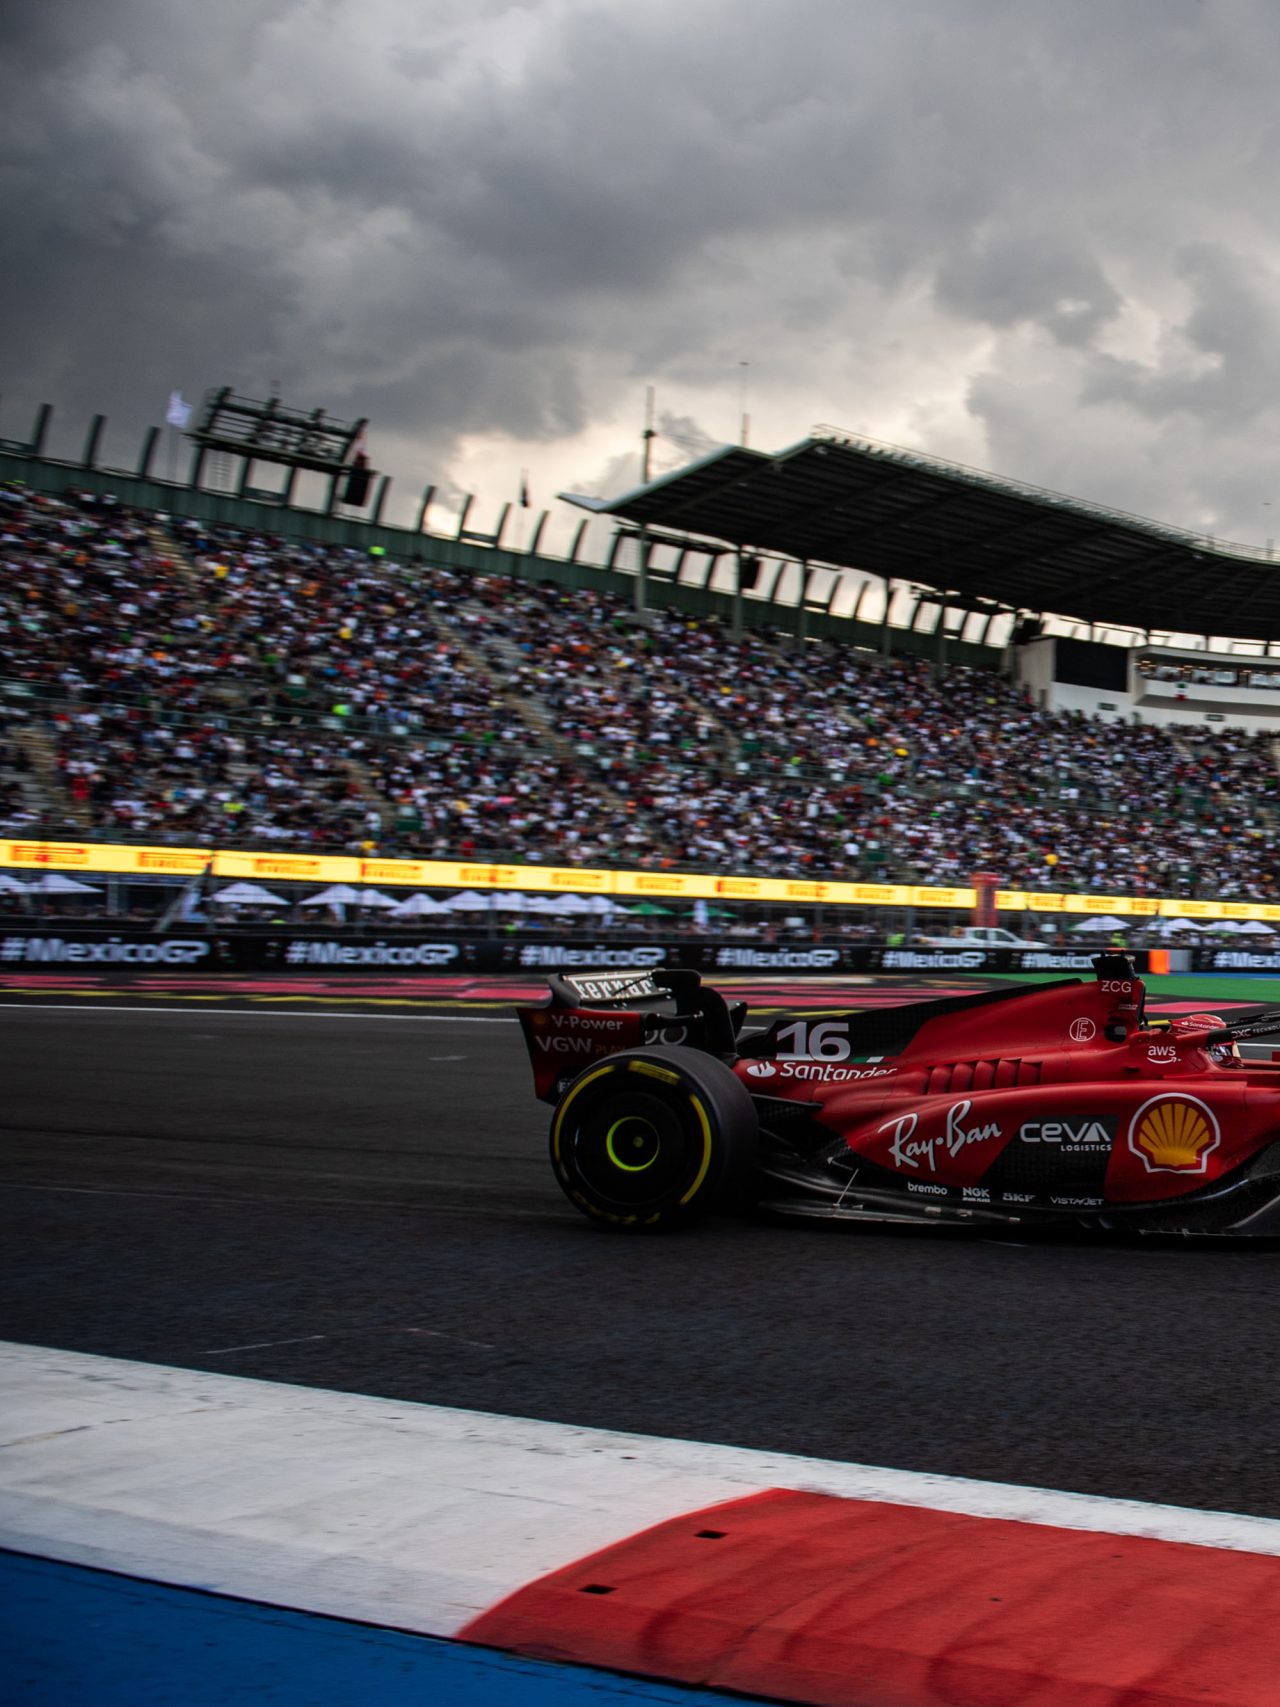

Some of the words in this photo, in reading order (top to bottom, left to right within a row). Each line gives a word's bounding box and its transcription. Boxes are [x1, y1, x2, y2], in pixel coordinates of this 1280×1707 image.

[1, 938, 210, 963] #MexicoGP
[286, 941, 459, 966] #MexicoGP
[519, 945, 667, 967] #MexicoGP
[715, 948, 839, 968] #MexicoGP
[1021, 951, 1101, 969] #Mexico
[573, 978, 653, 1000] Ferrar
[551, 1014, 624, 1032] V-Power
[535, 1034, 592, 1054] VGW
[776, 1021, 851, 1062] 16
[1147, 1044, 1177, 1057] aws
[779, 1061, 898, 1082] Santander
[1060, 1144, 1113, 1152] LOGISTICS
[907, 1181, 948, 1196] brembo
[962, 1186, 991, 1198] NGK
